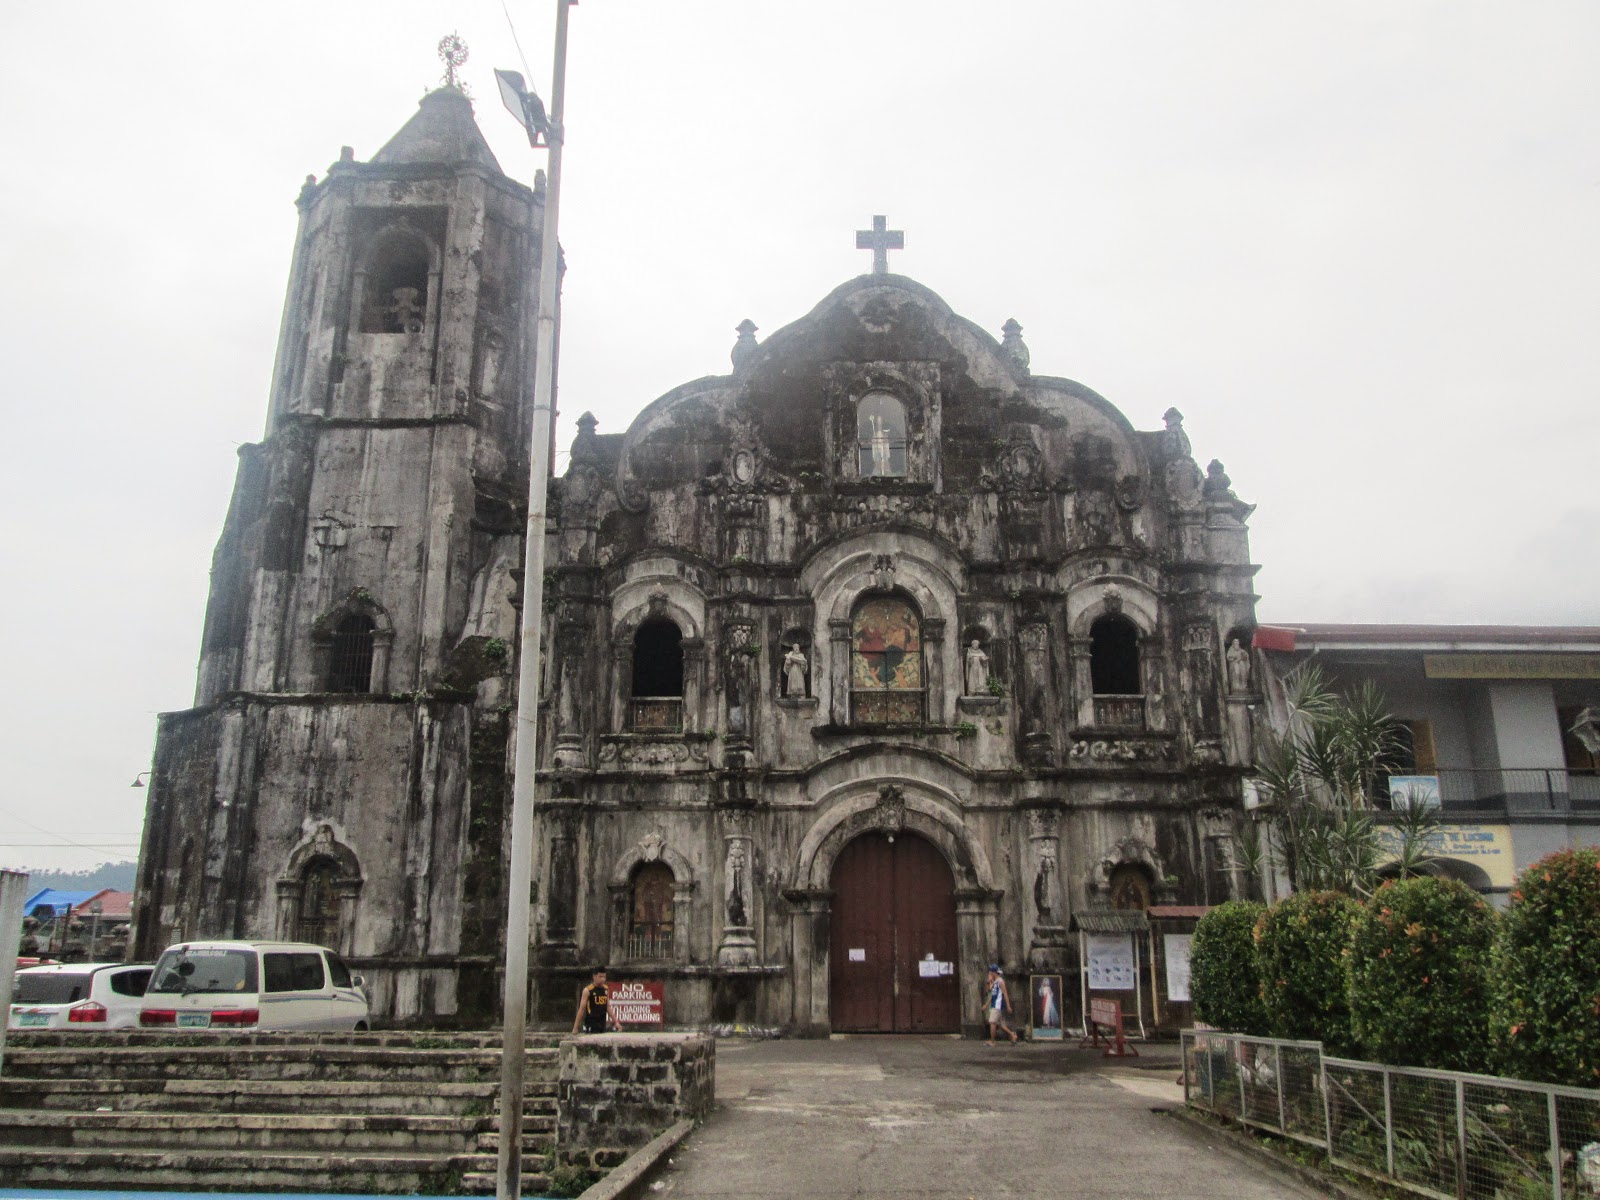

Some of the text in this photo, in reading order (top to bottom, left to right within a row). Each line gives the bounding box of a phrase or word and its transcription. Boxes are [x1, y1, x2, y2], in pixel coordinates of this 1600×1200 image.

[621, 983, 644, 992] NO
[612, 991, 653, 1000] PARKING
[619, 1005, 651, 1014] LOADING
[619, 1013, 660, 1022] UNLOADING
